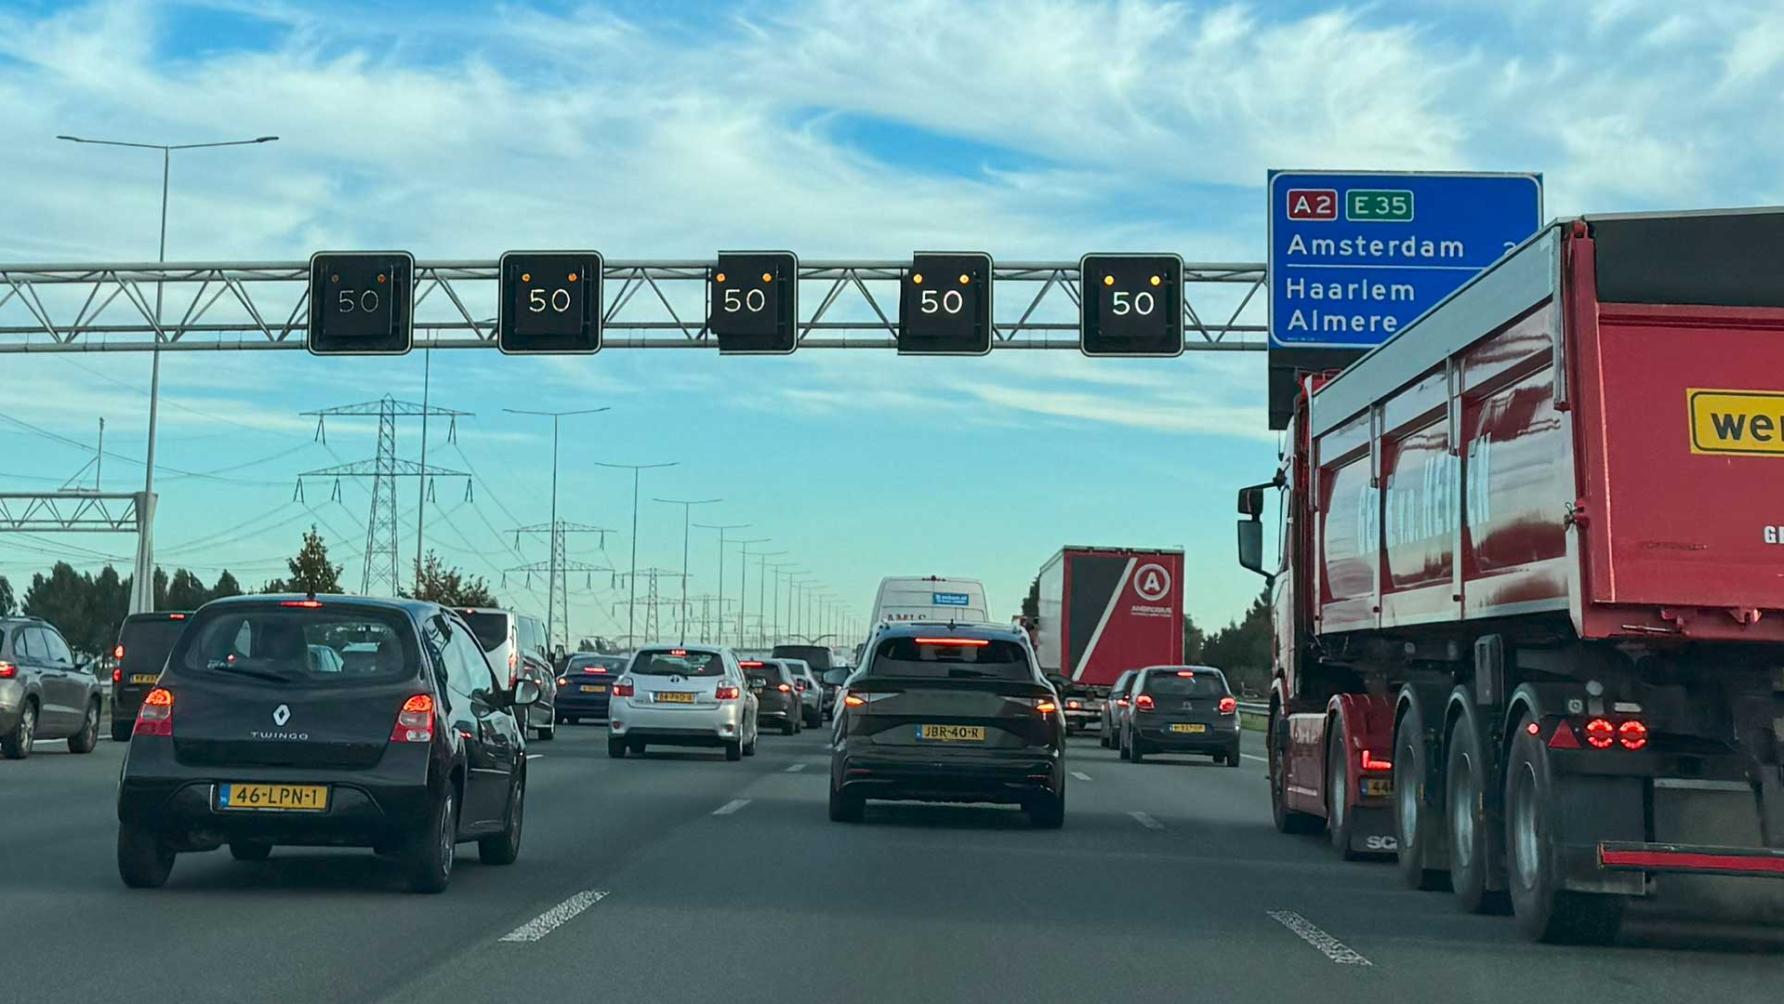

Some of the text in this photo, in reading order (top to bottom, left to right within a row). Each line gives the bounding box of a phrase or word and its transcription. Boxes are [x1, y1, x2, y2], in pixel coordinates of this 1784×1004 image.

[1287, 234, 1464, 258] Amsterdam
[338, 289, 380, 313] 50
[529, 288, 571, 312] 50
[724, 288, 766, 313] 50
[1286, 278, 1415, 300] Haarlem
[920, 289, 963, 315] 50
[1112, 291, 1155, 316] 50
[1287, 309, 1398, 332] Almere
[1143, 571, 1160, 591] A
[250, 731, 309, 741] TWINGO
[236, 787, 317, 806] 46-LPN-1
